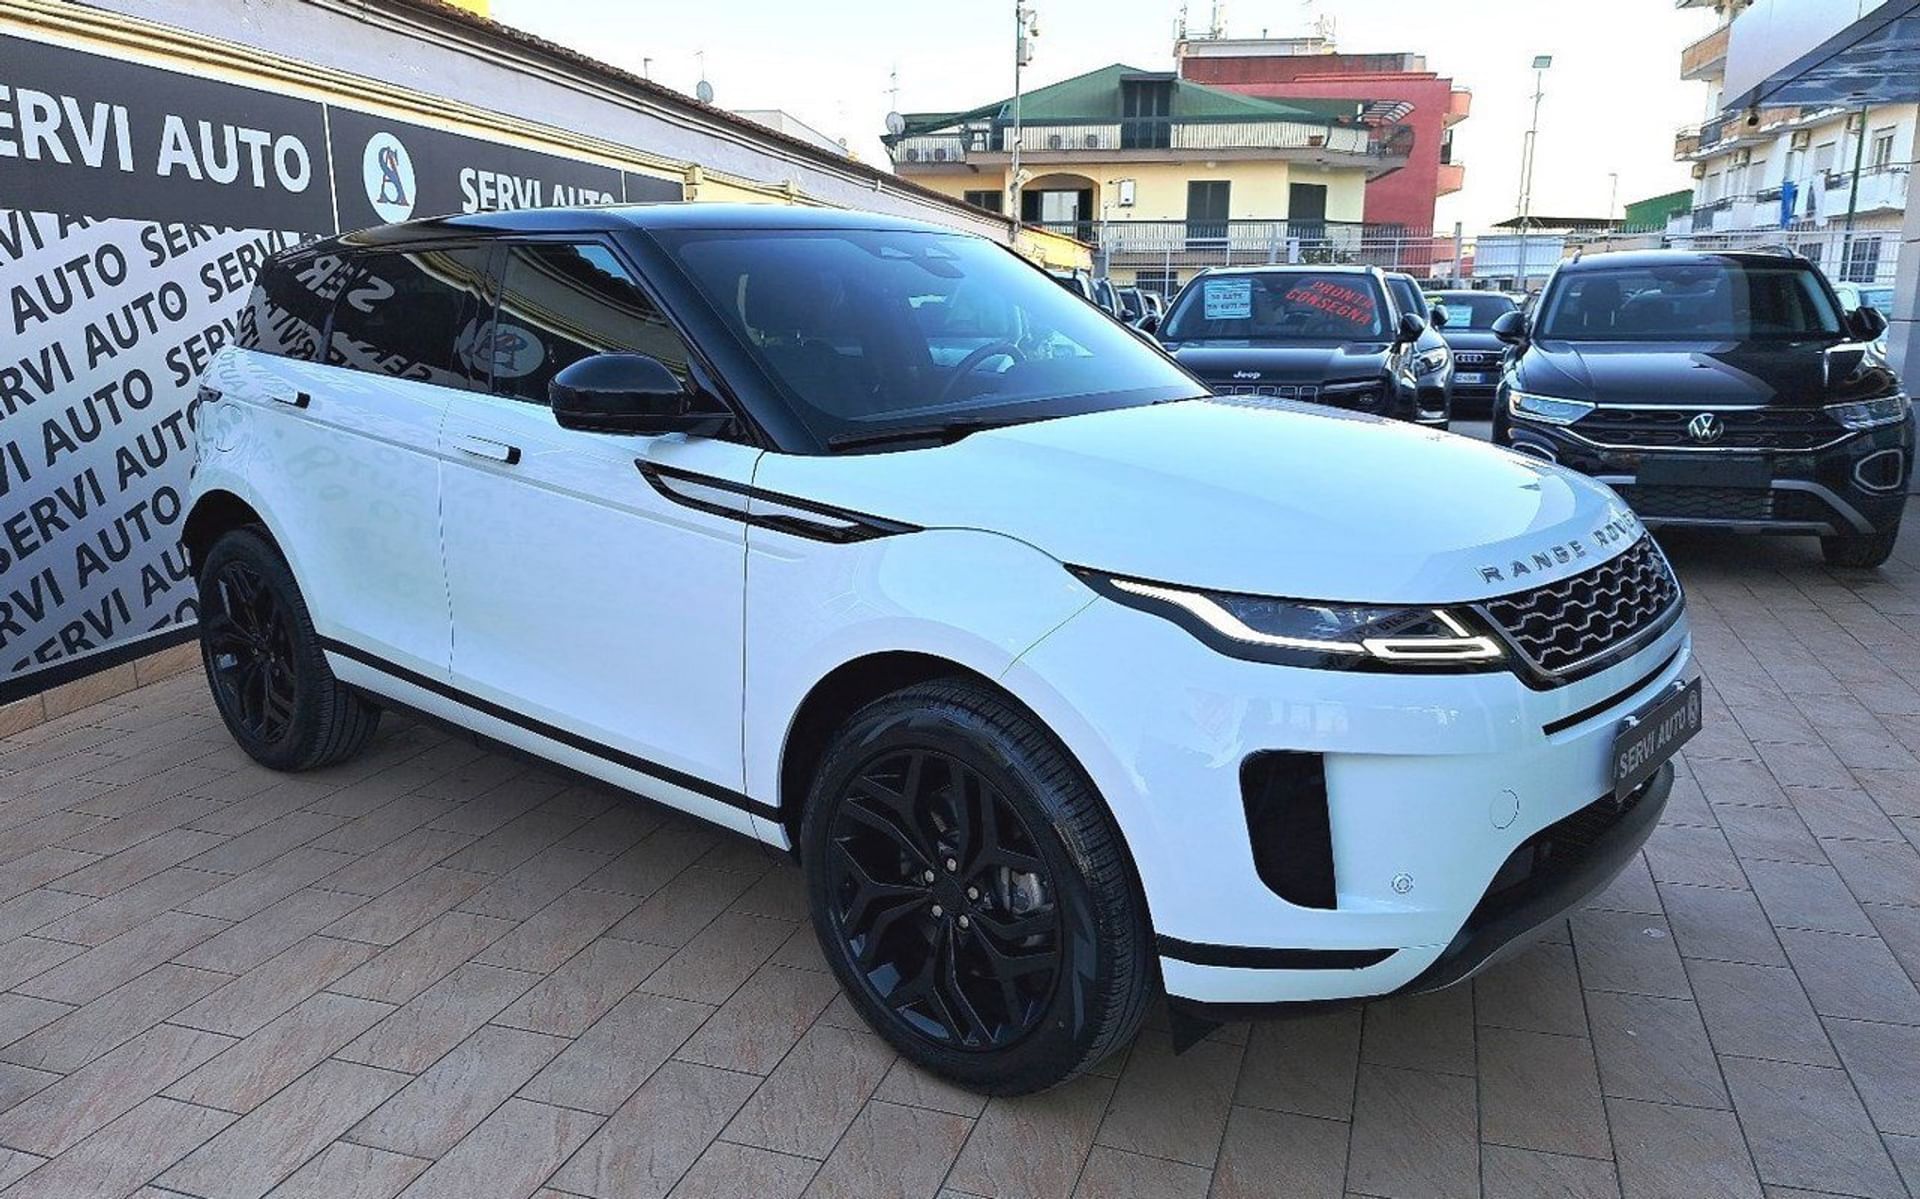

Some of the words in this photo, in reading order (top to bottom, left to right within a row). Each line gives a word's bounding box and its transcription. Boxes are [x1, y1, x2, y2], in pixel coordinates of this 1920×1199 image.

[156, 114, 311, 193] AUTO
[460, 167, 542, 214] SERVI
[552, 184, 615, 206] AU
[11, 243, 127, 335] AUTO
[140, 219, 242, 268] SER
[1285, 288, 1372, 325] CONSEGNA
[0, 341, 74, 420] RVI
[84, 281, 188, 371] AUTO
[1233, 370, 1261, 379] Jeep
[42, 368, 153, 468] AUTO
[75, 486, 181, 589] AUTO
[1474, 540, 1587, 584] RANGE
[141, 541, 191, 608] AU
[1620, 730, 1655, 778] SERVI
[1657, 705, 1686, 749] AUTO
